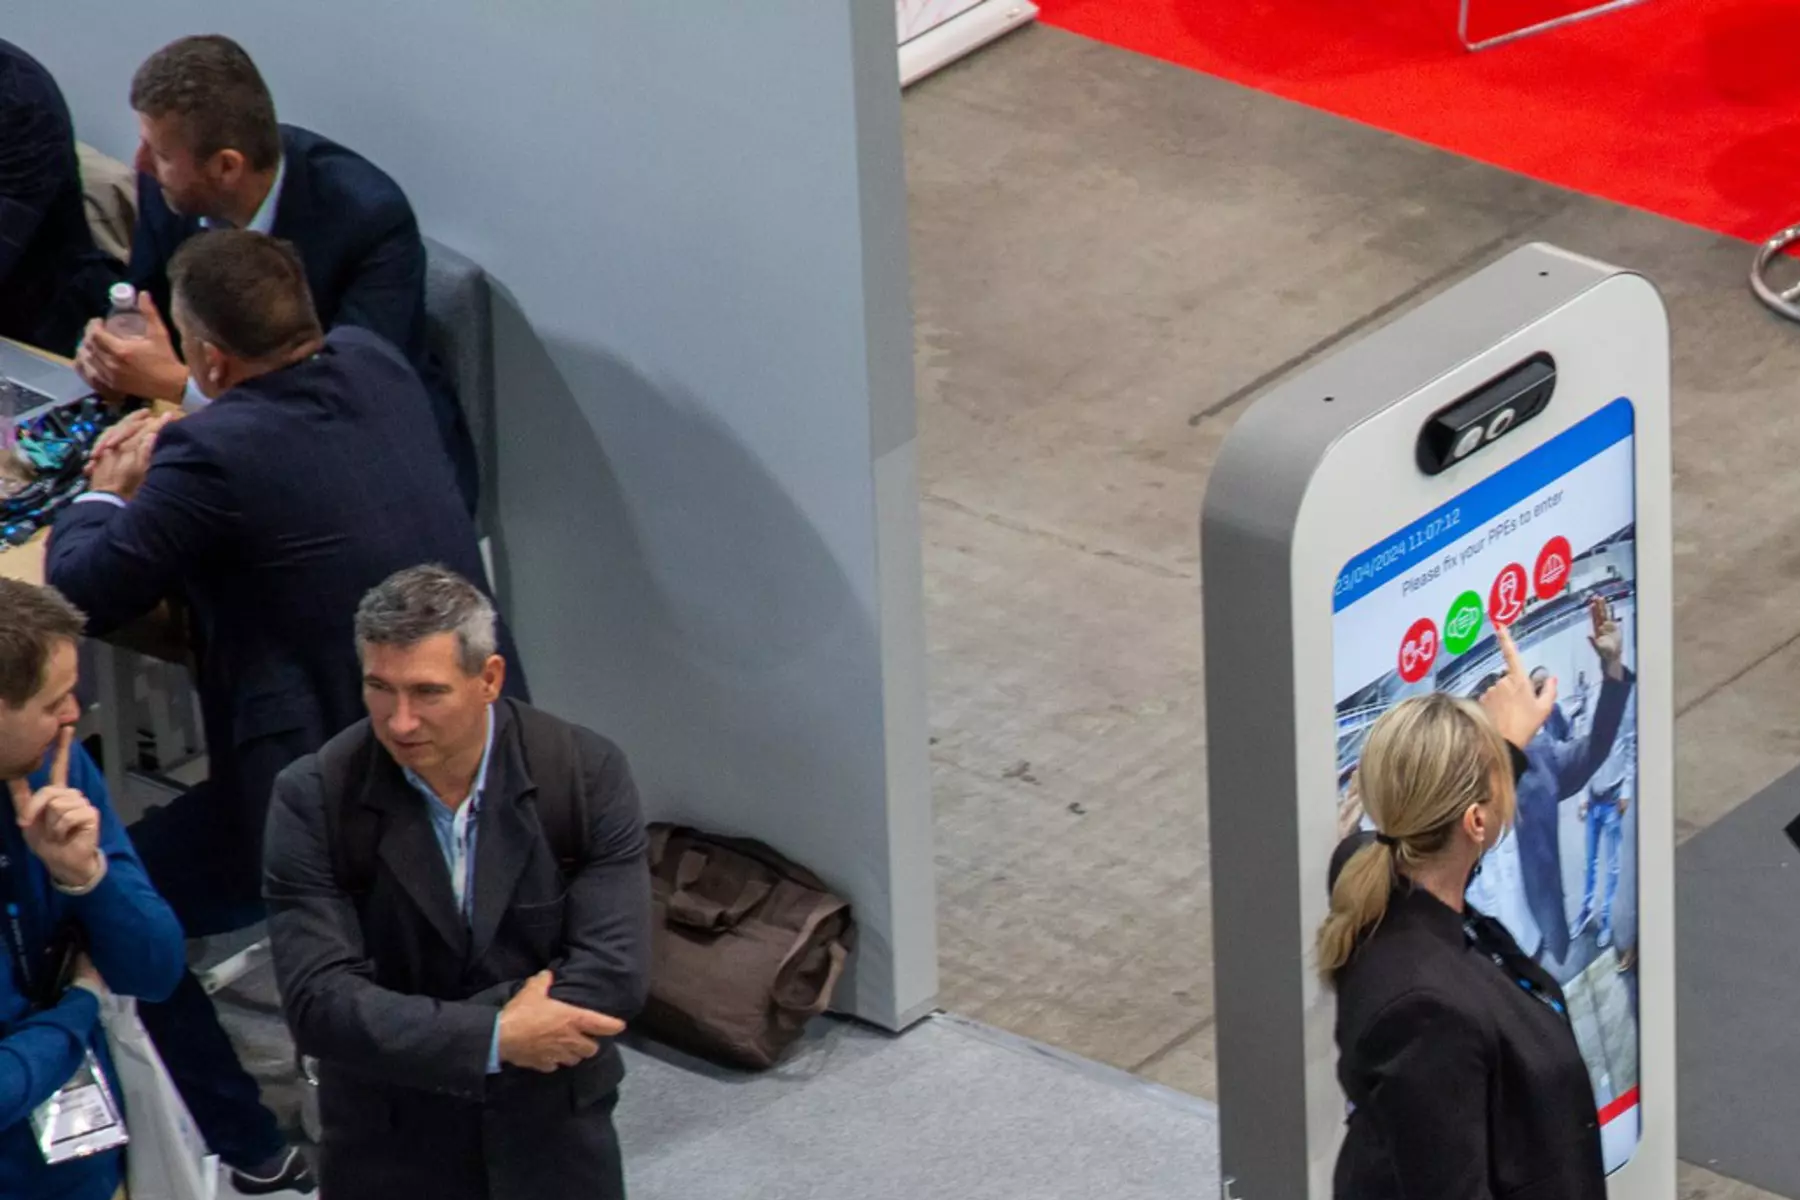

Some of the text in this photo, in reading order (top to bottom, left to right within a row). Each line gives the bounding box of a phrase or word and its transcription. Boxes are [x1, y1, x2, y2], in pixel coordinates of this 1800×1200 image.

[1334, 507, 1461, 596] 23/04/2024 11:07:12
[1401, 489, 1565, 598] Please fix your PPEs to enter
